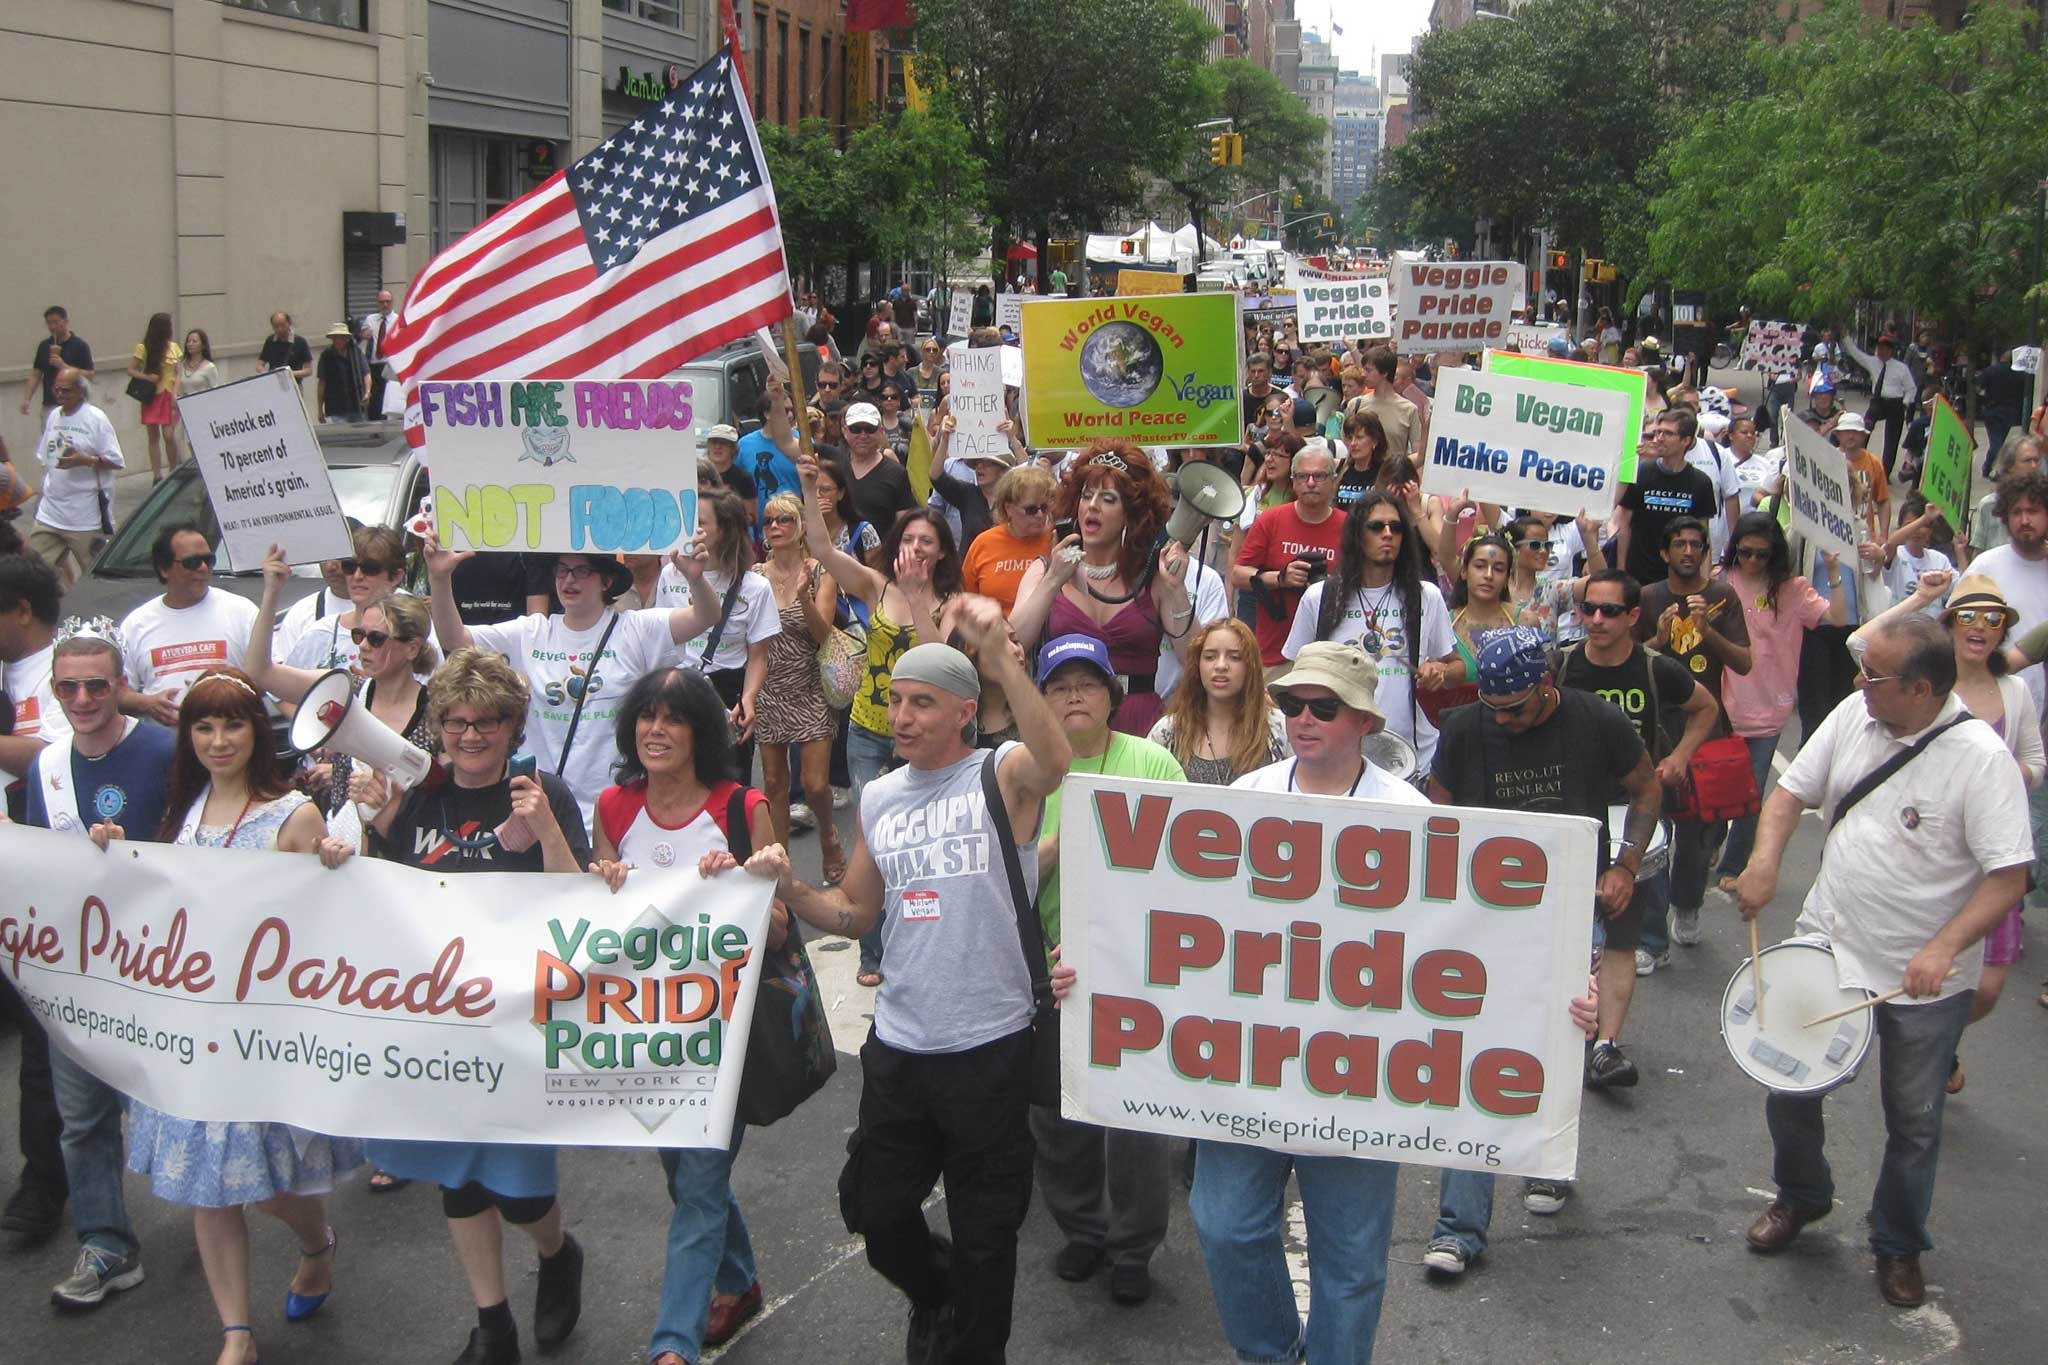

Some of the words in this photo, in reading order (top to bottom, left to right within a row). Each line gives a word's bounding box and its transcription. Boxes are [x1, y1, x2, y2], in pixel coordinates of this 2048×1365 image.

[1303, 283, 1382, 303] Veggie
[1411, 263, 1508, 290] Veggie
[1314, 302, 1374, 321] Pride
[1419, 294, 1492, 315] Pride
[1060, 304, 1116, 352] World
[1122, 303, 1184, 350] Vegan
[1304, 319, 1386, 338] Parade
[1402, 318, 1502, 340] Parade
[1505, 332, 1548, 350] Chicke
[421, 382, 503, 427] FISH
[510, 382, 569, 428] ARE
[574, 382, 694, 431] FRIENDS
[1167, 372, 1235, 409] Vegan
[209, 411, 258, 439] Livestock
[258, 409, 276, 429] eat
[1064, 411, 1124, 428] World
[1130, 411, 1187, 427] Peace
[1454, 383, 1493, 418] Be
[1515, 392, 1604, 437] Vegan
[220, 451, 236, 471] 70
[236, 444, 275, 472] percent
[276, 438, 288, 459] of
[956, 432, 1001, 455] FACE
[1433, 436, 1508, 475] Make
[1519, 448, 1605, 491] Peace
[1794, 444, 1808, 479] Be
[1809, 456, 1843, 506] Vegan
[224, 477, 274, 503] America's
[275, 471, 309, 498] grain.
[262, 509, 314, 526] ENVIRONMENTAL
[314, 504, 336, 517] ISSUE.
[435, 484, 555, 549] NOT
[570, 484, 696, 554] FOOD!
[1793, 480, 1819, 525] Make
[1820, 500, 1854, 546] Peace
[994, 560, 1033, 573] PUMP
[669, 585, 688, 594] VEG
[199, 643, 216, 653] CAFE
[1495, 780, 1561, 798] GENERAT
[874, 790, 985, 851] OCCUPY
[942, 836, 987, 875] ST.
[1090, 789, 1549, 910] Veggie
[80, 895, 215, 993] Pride
[236, 916, 497, 1018] Parade
[547, 912, 749, 971] Veggie
[1144, 909, 1488, 1020] Pride
[232, 1028, 372, 1082] VivaVegie
[384, 1044, 505, 1093] Society
[1088, 992, 1546, 1119] Parade
[552, 1076, 601, 1088] NEW
[615, 1075, 681, 1087] YORK
[1122, 1098, 1502, 1166] www.veggieprideparade.org
